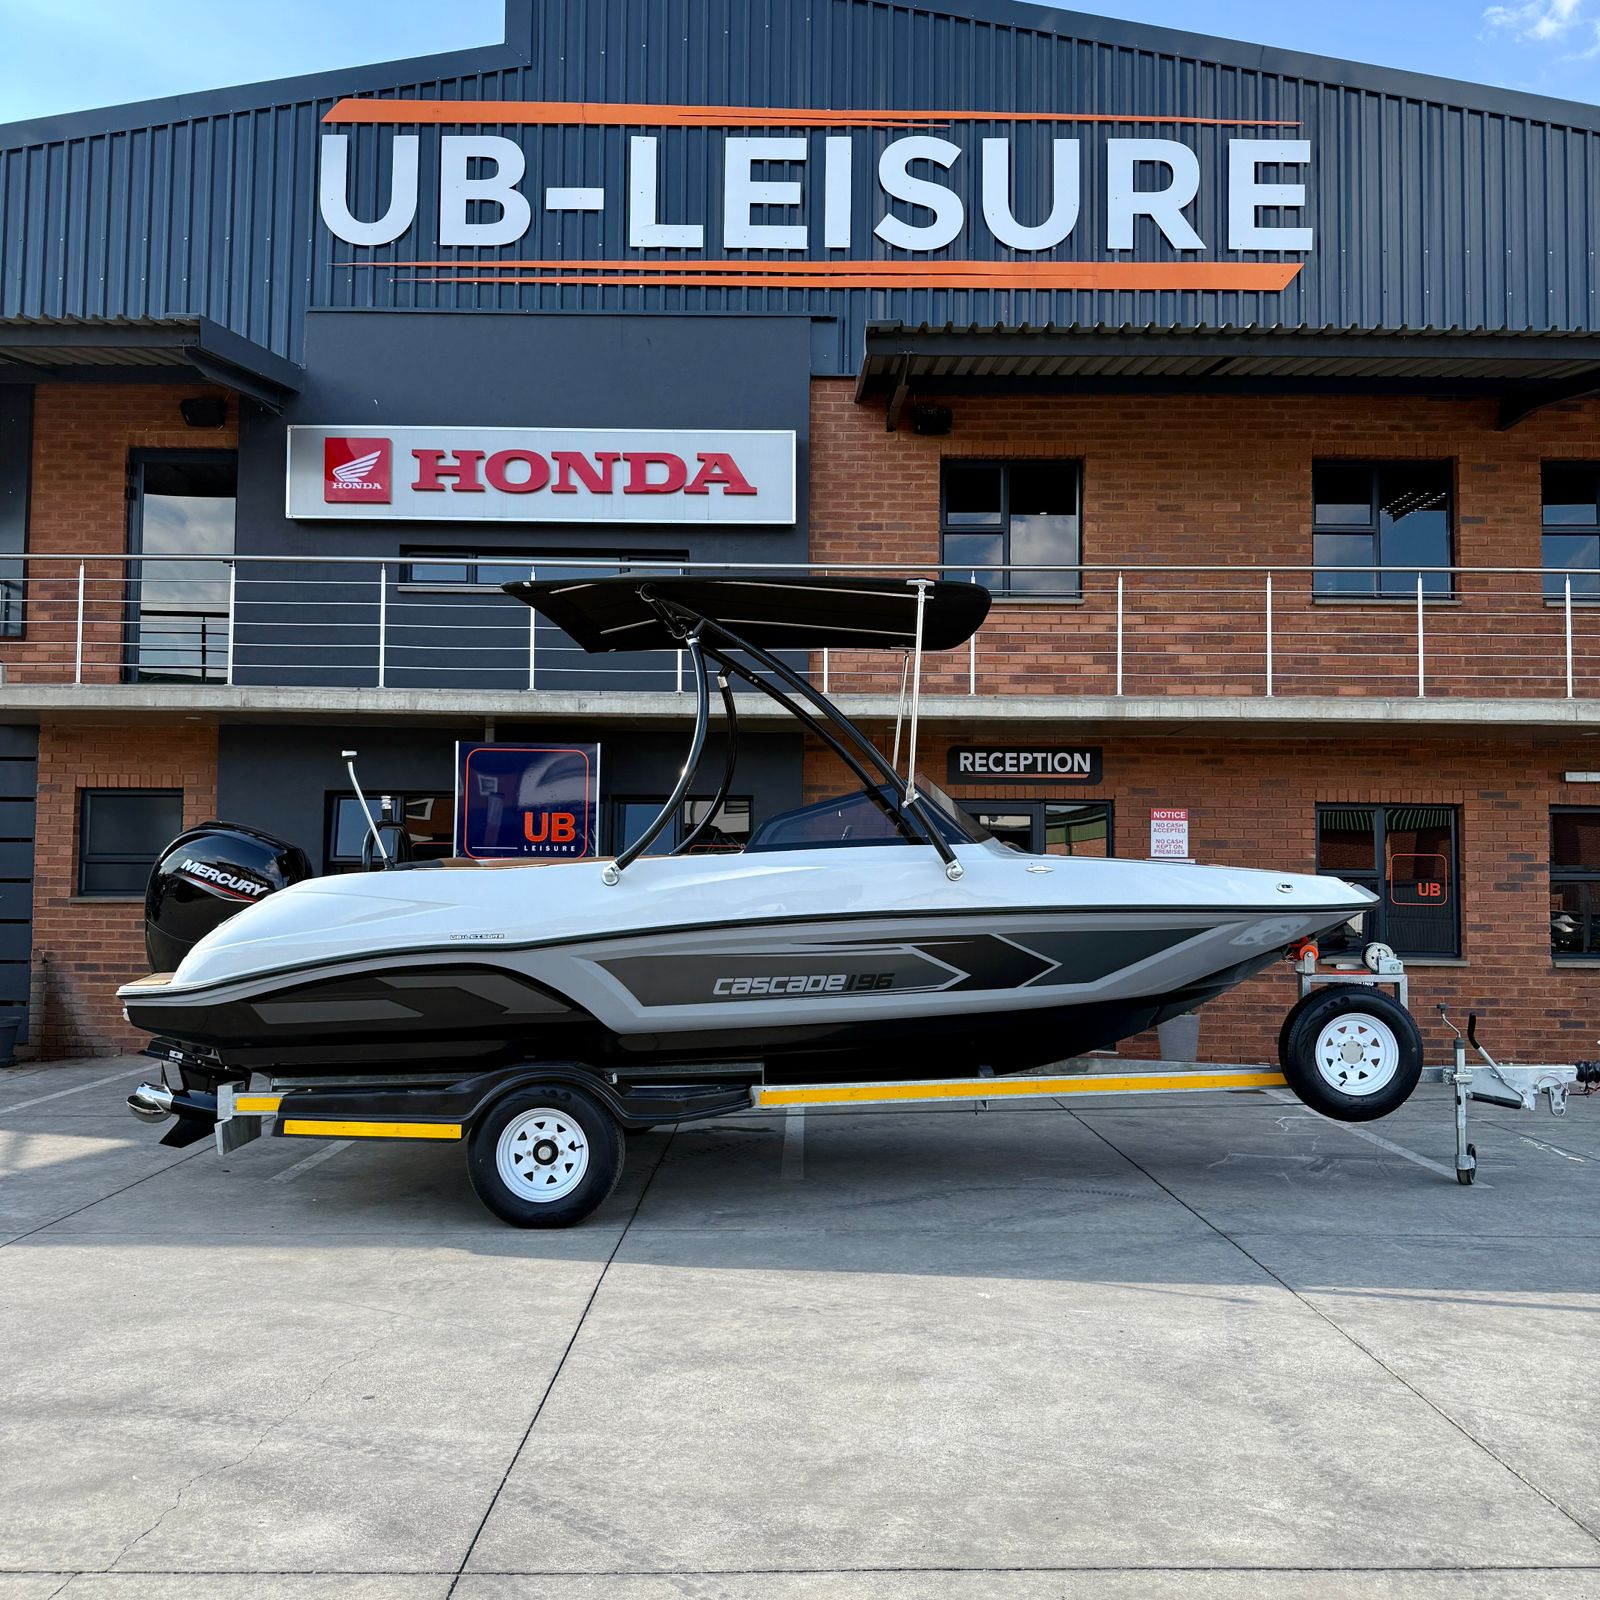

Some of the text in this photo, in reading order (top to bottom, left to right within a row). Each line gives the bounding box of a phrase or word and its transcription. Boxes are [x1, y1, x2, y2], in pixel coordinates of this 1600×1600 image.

[319, 134, 1314, 252] UB-LEISURE
[411, 447, 758, 497] HONDA
[959, 752, 1091, 772] RECEPTION
[524, 811, 576, 843] UB
[1153, 811, 1186, 819] NOTICE
[180, 858, 270, 897] MERCURY
[1417, 882, 1441, 897] UB
